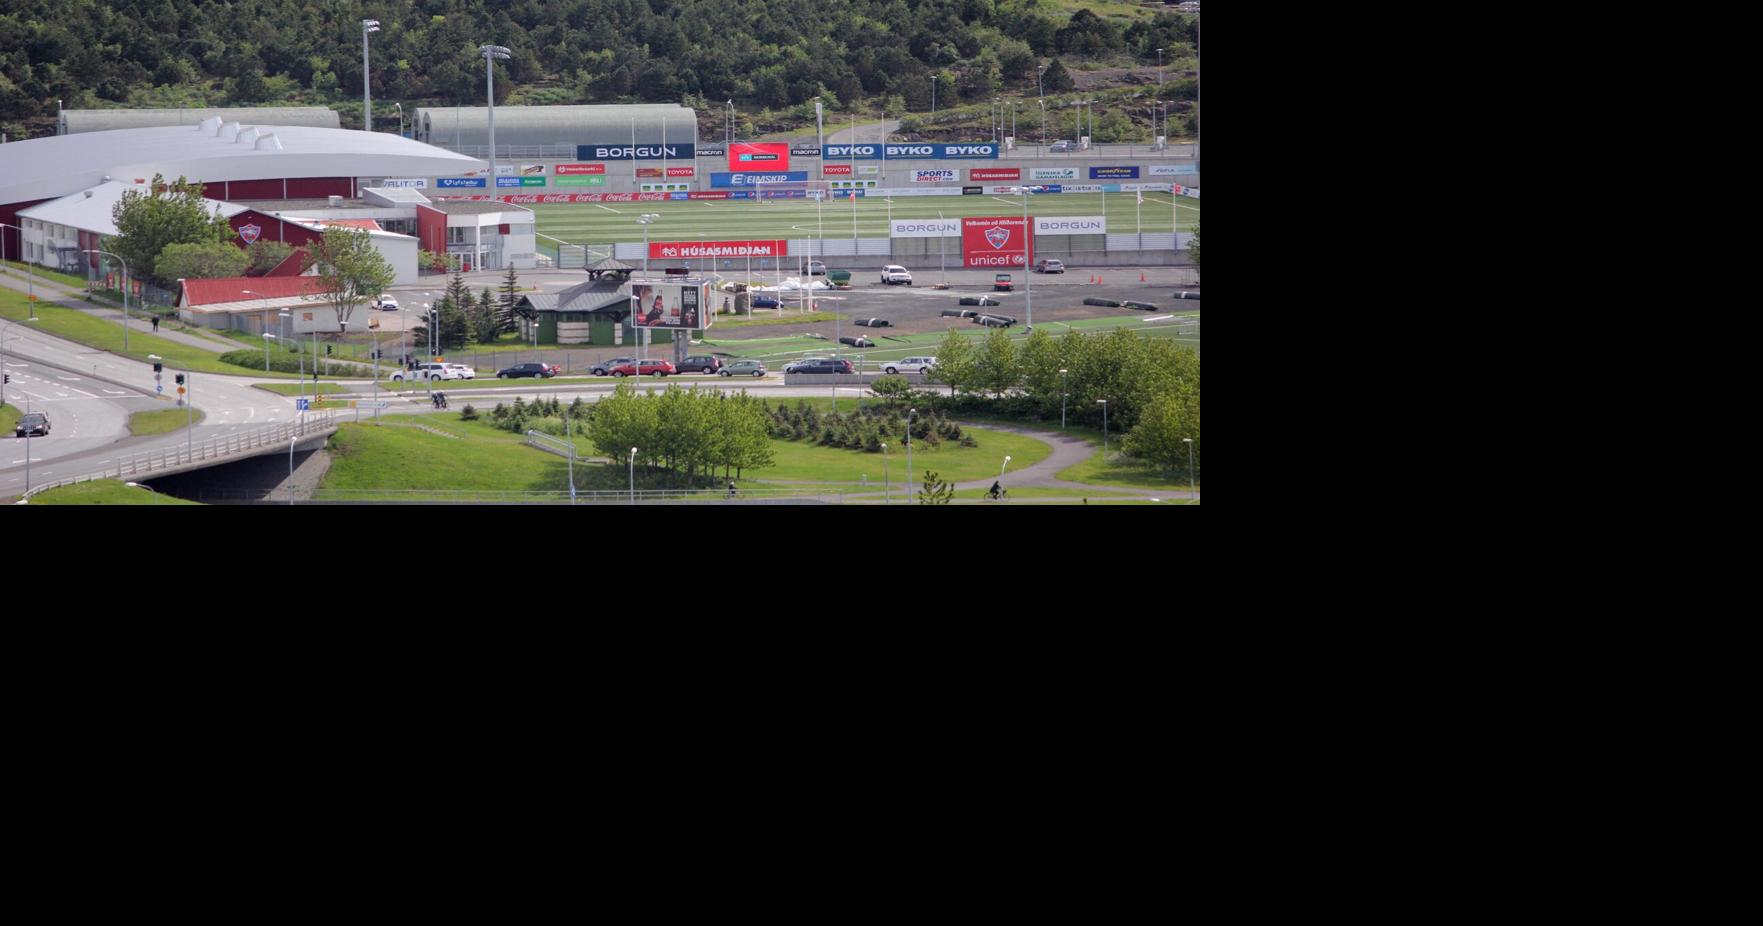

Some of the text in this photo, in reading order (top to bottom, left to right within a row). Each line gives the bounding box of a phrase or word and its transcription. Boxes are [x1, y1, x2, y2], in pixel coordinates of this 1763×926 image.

[596, 147, 676, 158] BORGUN
[828, 146, 874, 155] BYKO
[887, 146, 933, 155] BYKO
[945, 146, 992, 155] BYKO
[746, 175, 787, 183] EIMSKIP
[896, 224, 956, 232] BORGUN
[1040, 221, 1100, 230] BORGUN
[970, 254, 1010, 266] unicef
